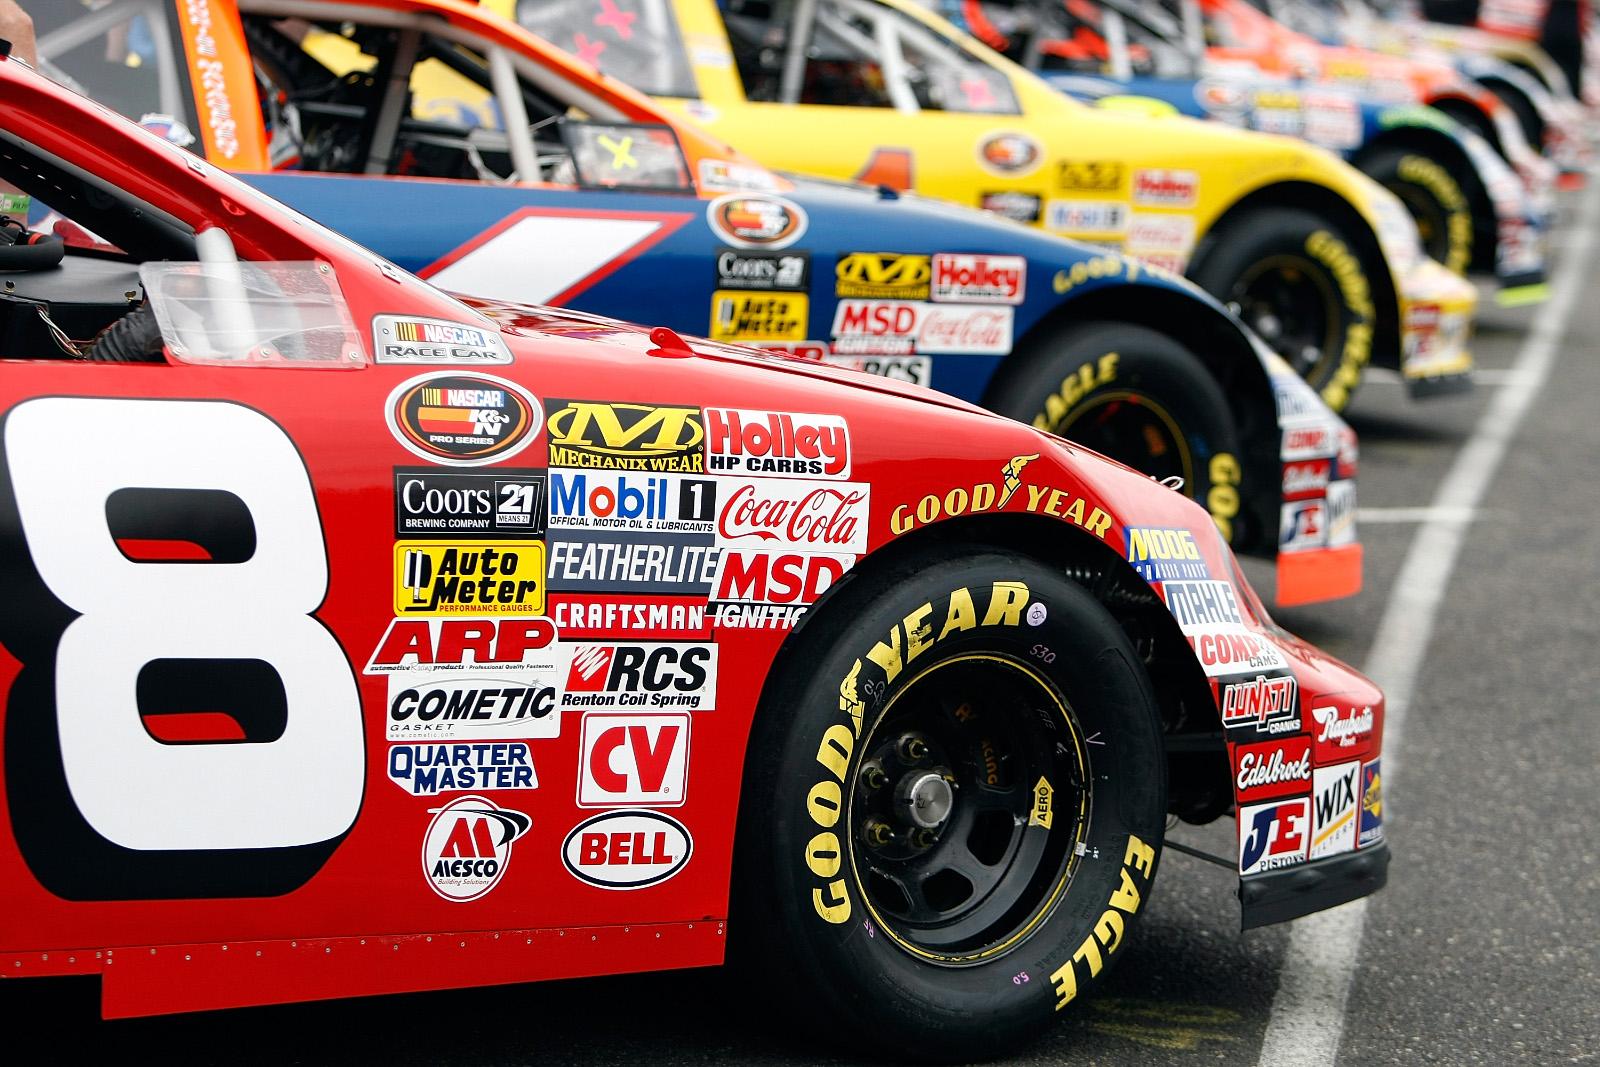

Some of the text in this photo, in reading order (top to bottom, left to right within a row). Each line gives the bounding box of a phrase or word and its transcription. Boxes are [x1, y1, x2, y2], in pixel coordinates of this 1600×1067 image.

[938, 258, 1019, 297] Holley
[742, 299, 789, 315] Auto
[841, 305, 916, 335] MSD
[424, 326, 485, 347] NASCAR
[447, 389, 502, 408] NASCAR
[429, 435, 495, 445] PRO SERIES
[706, 409, 848, 475] Holley
[548, 444, 704, 473] MECHANIX WEAR
[710, 456, 823, 475] HP CARBS
[402, 479, 492, 515] Coors
[498, 484, 535, 513] 21
[550, 473, 704, 520] Mobil 1
[405, 518, 490, 528] BREWING COMPANY
[498, 514, 529, 523] MEANS 21
[550, 516, 714, 532] OFFICIAL MOTOR OIL & LUBRICANTS
[718, 484, 869, 545] Coca-Cola
[1128, 528, 1200, 563] MOOG
[437, 549, 519, 576] Auto
[547, 541, 718, 584] FEATHERLITE
[433, 577, 537, 604] Meter
[717, 552, 844, 604] MSD
[440, 604, 533, 612] PERFORMANCE GAUGES
[555, 602, 704, 630] CRAFTSMAN
[3, 396, 366, 851] 8
[372, 619, 555, 665] ARP
[369, 664, 411, 672] automotive
[433, 663, 465, 672] products
[606, 646, 711, 692] RCS
[1249, 655, 1279, 668] CAMS
[390, 687, 556, 721] COMETIC
[561, 693, 701, 708] Renton Coil Spring
[1223, 677, 1295, 723] LUNATI
[390, 723, 456, 731] GASKET
[1269, 719, 1301, 735] CRANKS
[389, 743, 528, 780] QUARTER
[589, 725, 680, 793] CV
[1237, 748, 1312, 790] Edelbrock
[413, 766, 533, 794] MASTER
[1036, 786, 1050, 822] AERO
[1315, 767, 1355, 830] WIX
[578, 831, 673, 866] BELL
[1259, 852, 1306, 871] PISTONS
[432, 859, 499, 878] MESCO
[437, 878, 462, 887] Building
[1049, 833, 1156, 1013] EAGLE
